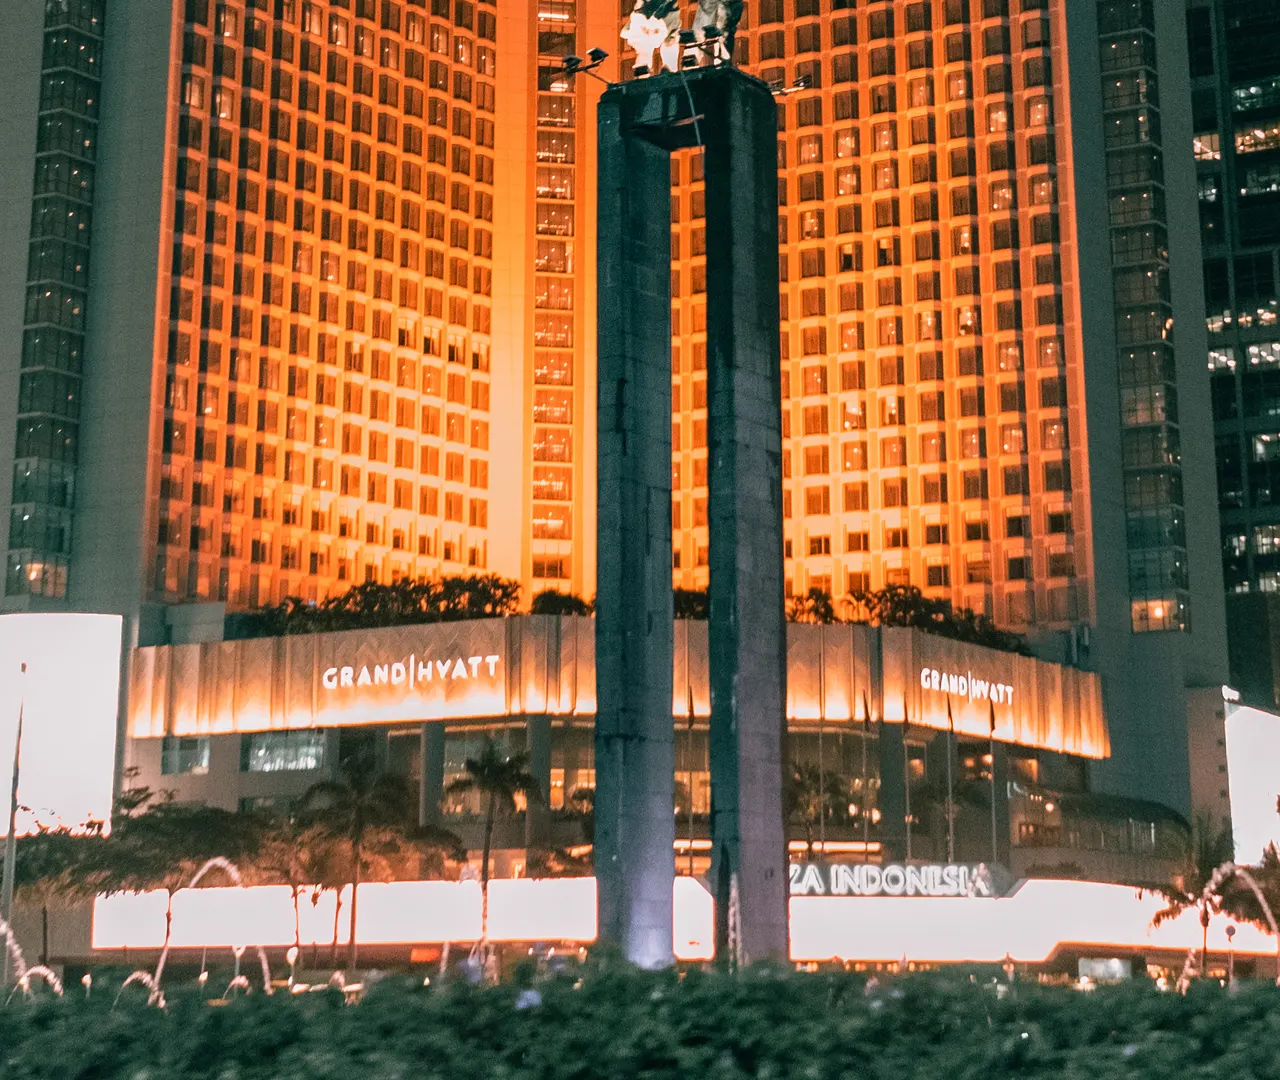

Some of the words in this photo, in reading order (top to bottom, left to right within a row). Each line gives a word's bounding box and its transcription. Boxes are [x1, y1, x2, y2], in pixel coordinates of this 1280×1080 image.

[322, 662, 407, 690] GRAND
[417, 655, 500, 682] HYATT
[920, 667, 968, 697] GRAND
[971, 677, 1014, 707] HYATT
